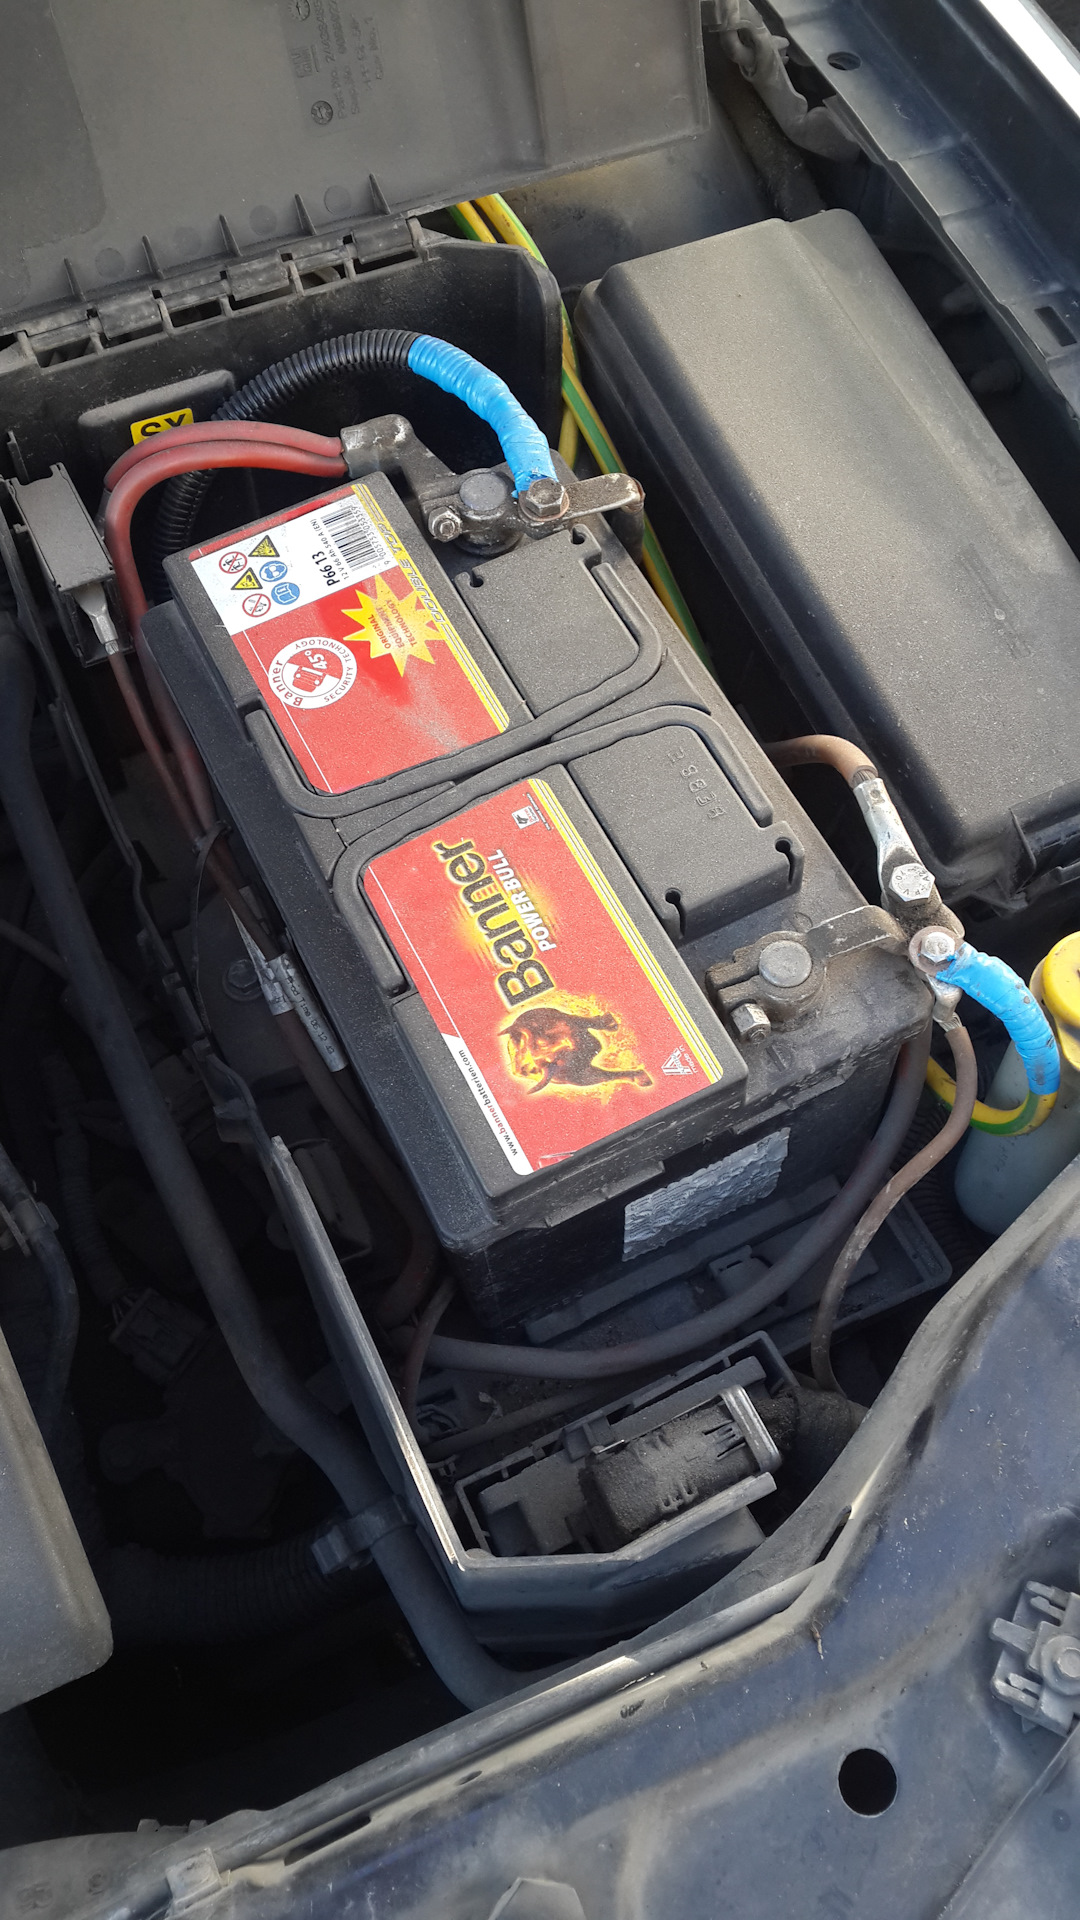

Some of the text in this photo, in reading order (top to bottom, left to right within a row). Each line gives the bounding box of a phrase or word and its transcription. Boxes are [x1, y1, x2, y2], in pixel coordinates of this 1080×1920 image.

[309, 518, 322, 532] (EN)
[320, 536, 332, 549] 540
[311, 550, 341, 586] P66 13
[328, 548, 337, 557] Ah
[333, 558, 342, 567] 66
[377, 522, 446, 623] DOUBLE TOP
[341, 571, 350, 580] 12
[367, 613, 392, 650] ORIGINAL
[376, 606, 405, 648] EQUIPMENT
[386, 599, 418, 648] TECHNOLOGY
[272, 659, 303, 707] Banner
[295, 638, 354, 703] SECURITY TECHNOLOGY
[487, 848, 557, 952] POWER BULL
[432, 839, 556, 1008] Banner
[458, 1049, 519, 1157] www.bannerbatterien.com
